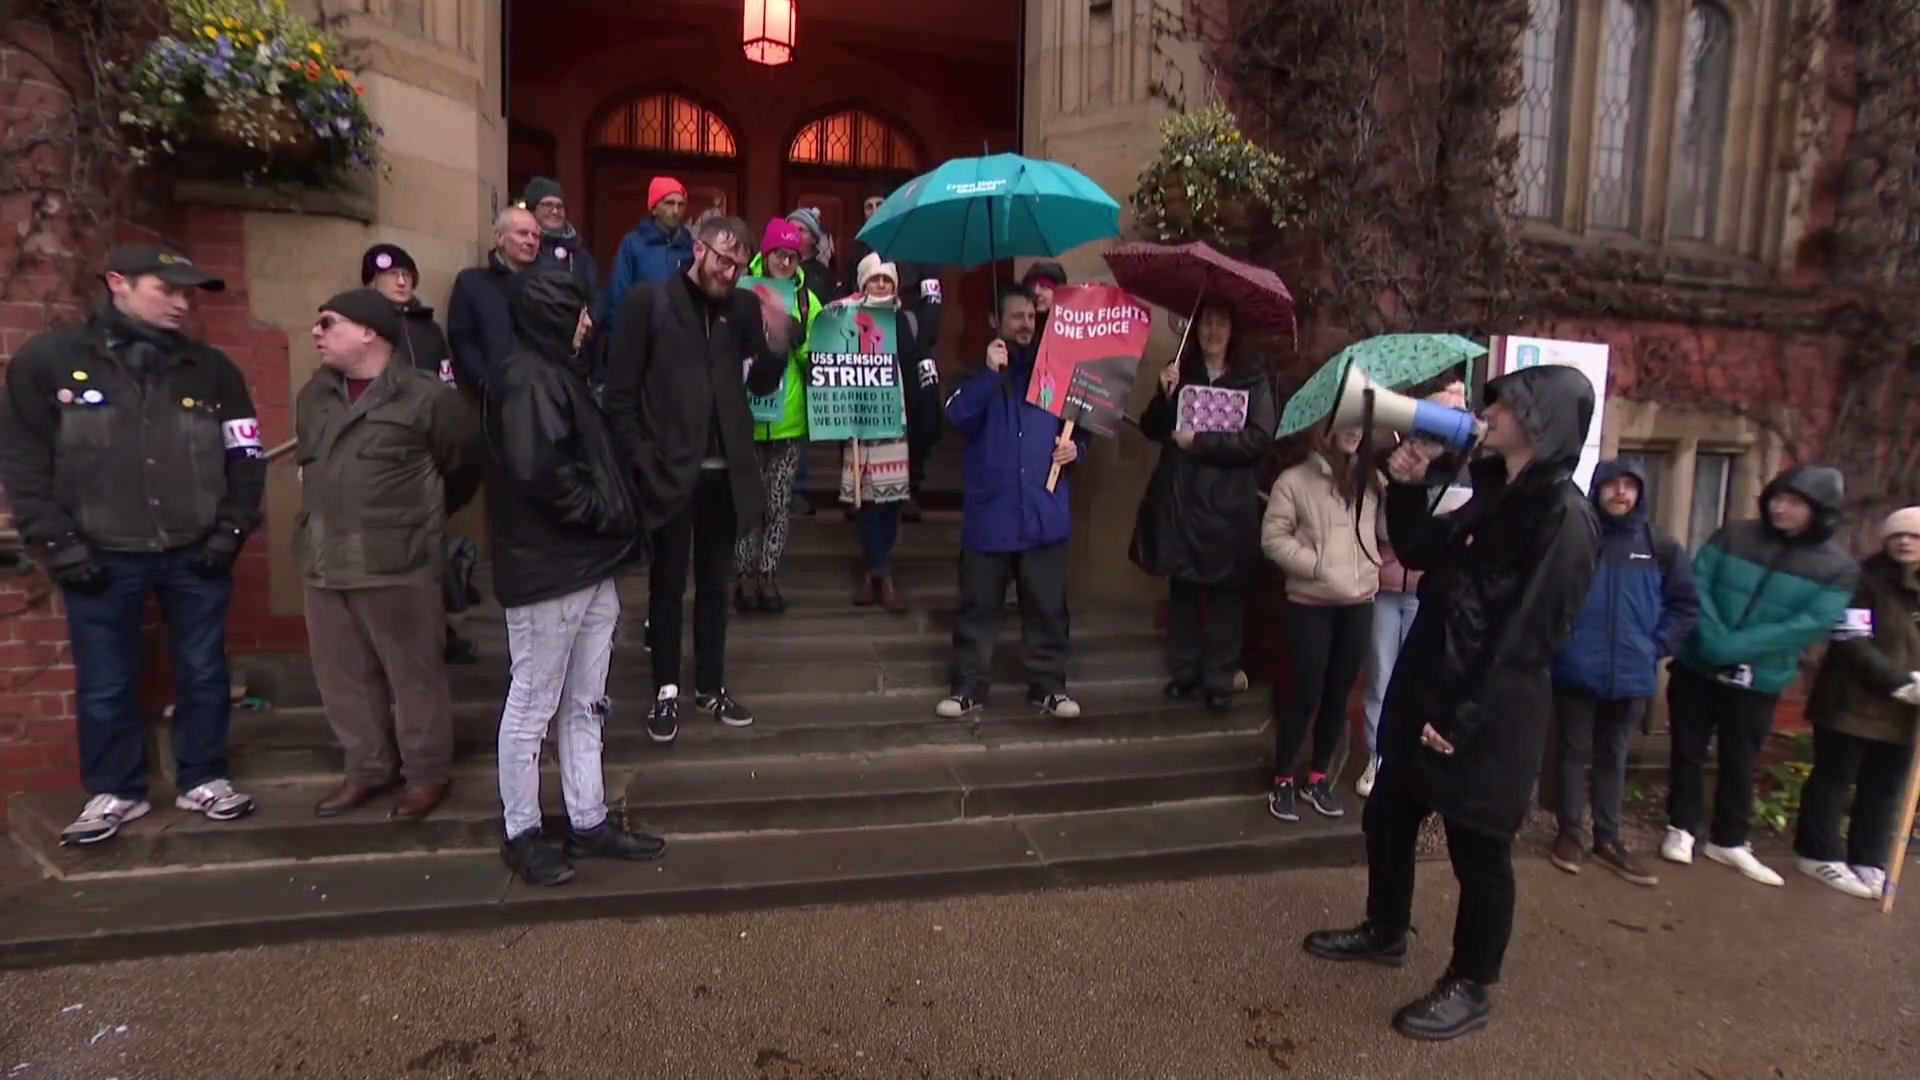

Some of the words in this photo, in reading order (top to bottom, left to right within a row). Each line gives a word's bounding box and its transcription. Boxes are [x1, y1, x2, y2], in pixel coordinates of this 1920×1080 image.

[1055, 304, 1094, 323] FOUR
[1098, 306, 1149, 324] FIGHTS
[1054, 320, 1084, 339] ONE
[1087, 320, 1129, 338] VOICE
[811, 352, 834, 365] USS
[836, 353, 893, 366] PENSION
[811, 366, 894, 387] STRIKE
[812, 391, 829, 401] WE
[832, 391, 877, 402] EARNED
[881, 391, 894, 401] IT.
[813, 404, 829, 414] WE
[833, 404, 879, 414] DESERVE
[882, 404, 895, 414] IT.
[814, 416, 831, 426] WE
[834, 416, 880, 426] DEMAND
[882, 417, 895, 426] IT.
